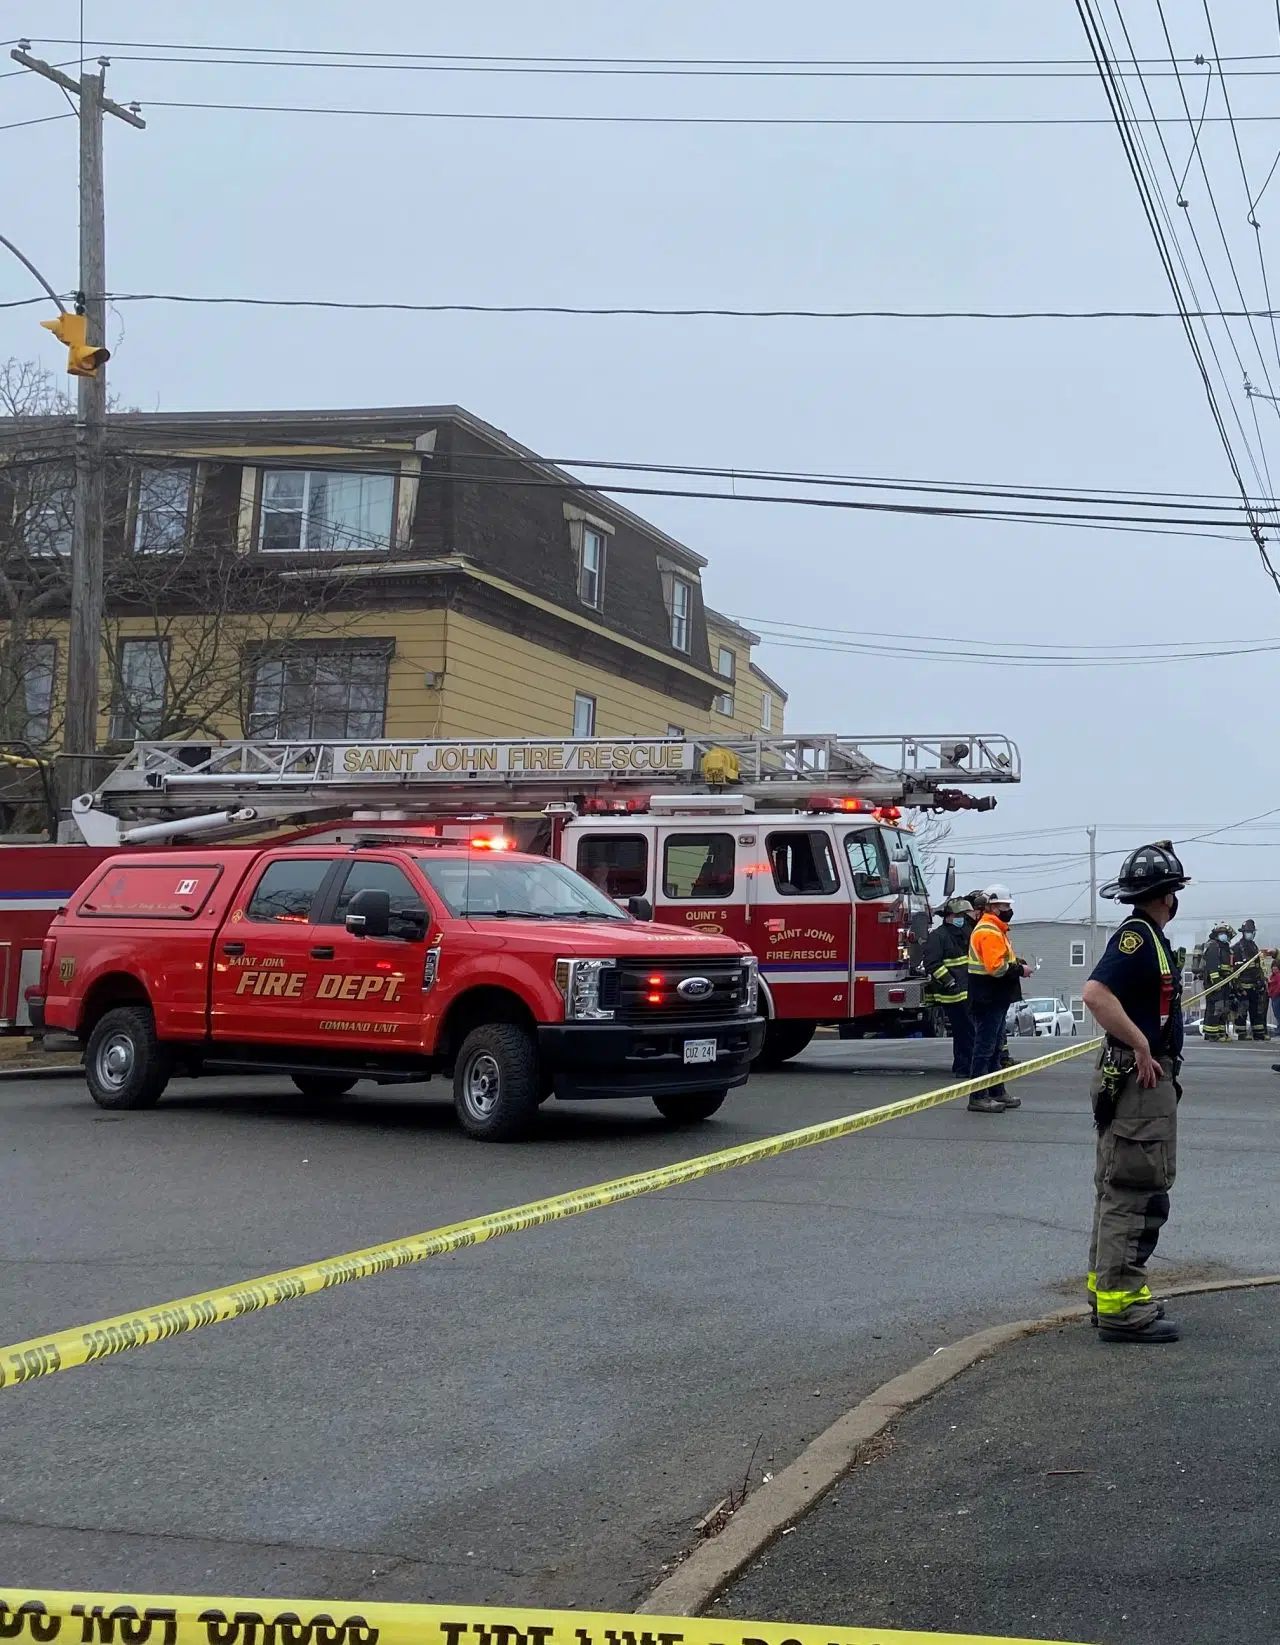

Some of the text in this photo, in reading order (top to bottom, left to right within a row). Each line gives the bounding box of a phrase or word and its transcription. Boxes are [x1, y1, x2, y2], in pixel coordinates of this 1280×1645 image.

[343, 745, 684, 772] SAINT JOHN FIRE/RESCUE
[686, 910, 727, 920] QUINT 5
[432, 933, 444, 944] 3
[769, 928, 835, 944] SAINT JOHN
[766, 950, 838, 960] FIRE/RESCUE
[229, 956, 285, 968] SAINT JOHN
[61, 962, 74, 977] 911
[235, 971, 405, 1002] FIRE DEPT.
[832, 994, 843, 1002] 43
[319, 1020, 399, 1033] COMMAND UNIT
[685, 1046, 714, 1059] CUZ 241
